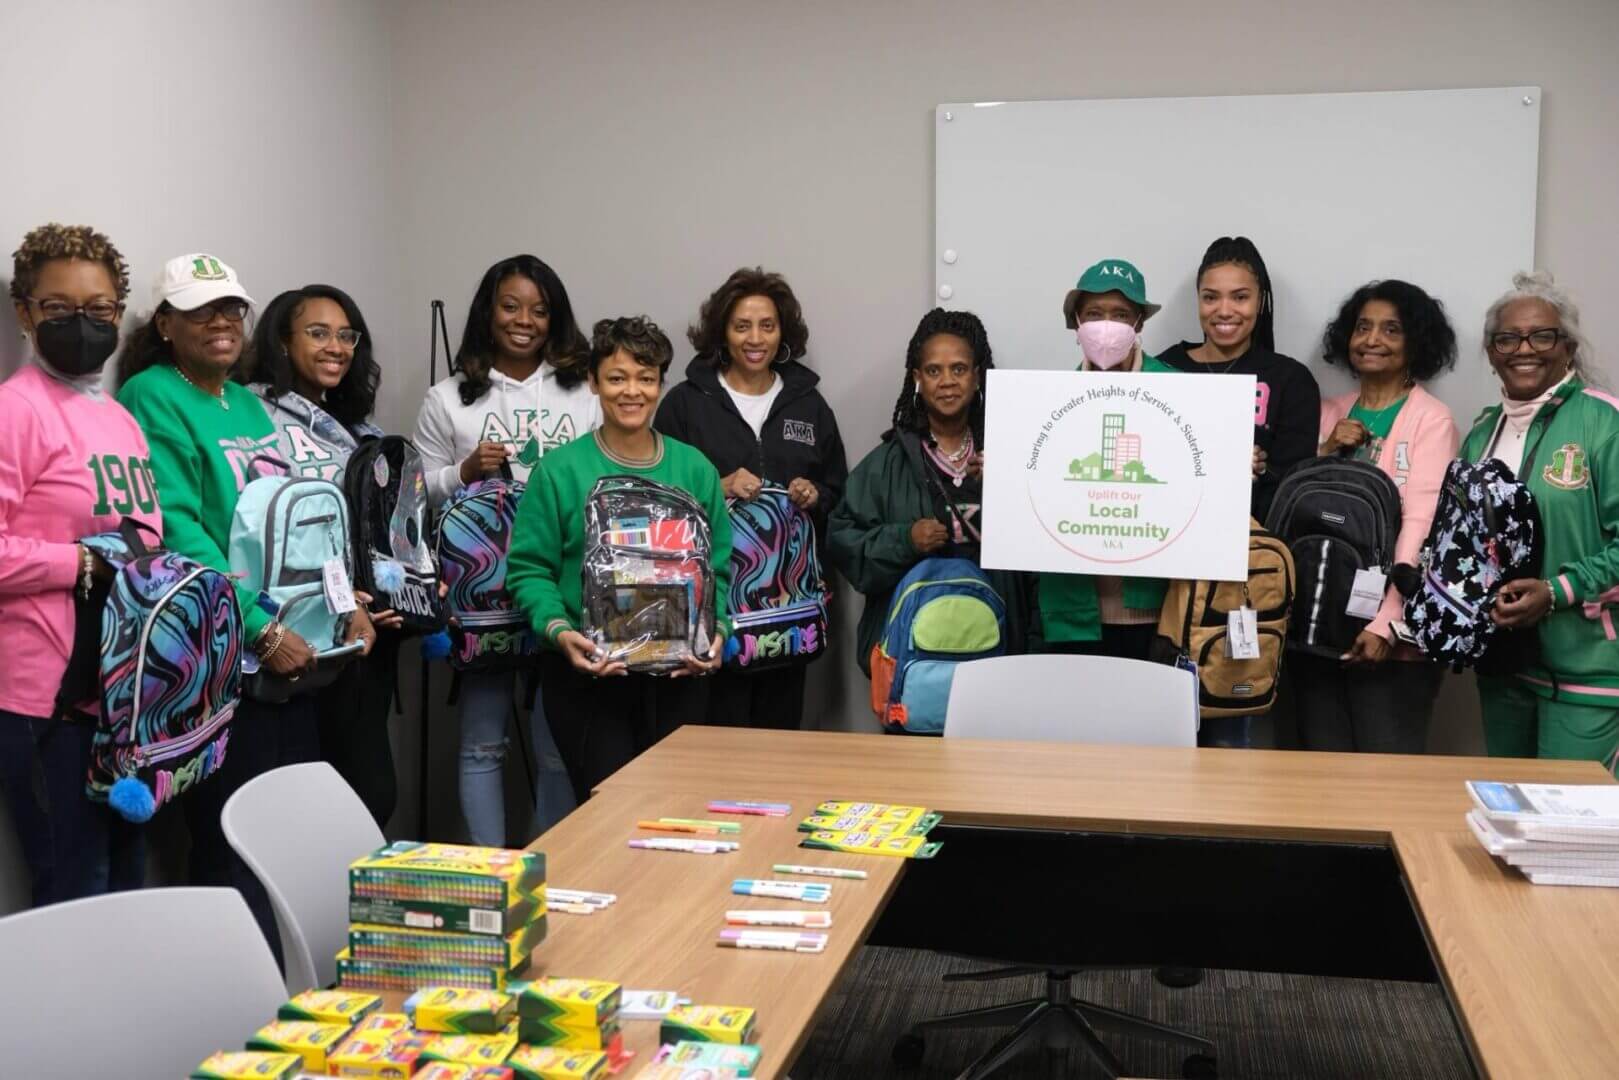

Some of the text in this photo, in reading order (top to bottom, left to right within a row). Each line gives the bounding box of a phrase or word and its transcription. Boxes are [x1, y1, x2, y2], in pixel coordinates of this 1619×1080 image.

[479, 409, 577, 444] AKA
[1026, 385, 1207, 477] Soaring to Greater Heights of Service & Sisterhood
[1087, 490, 1142, 501] Uplift Our
[1090, 503, 1138, 519] Local
[1057, 519, 1170, 542] Community
